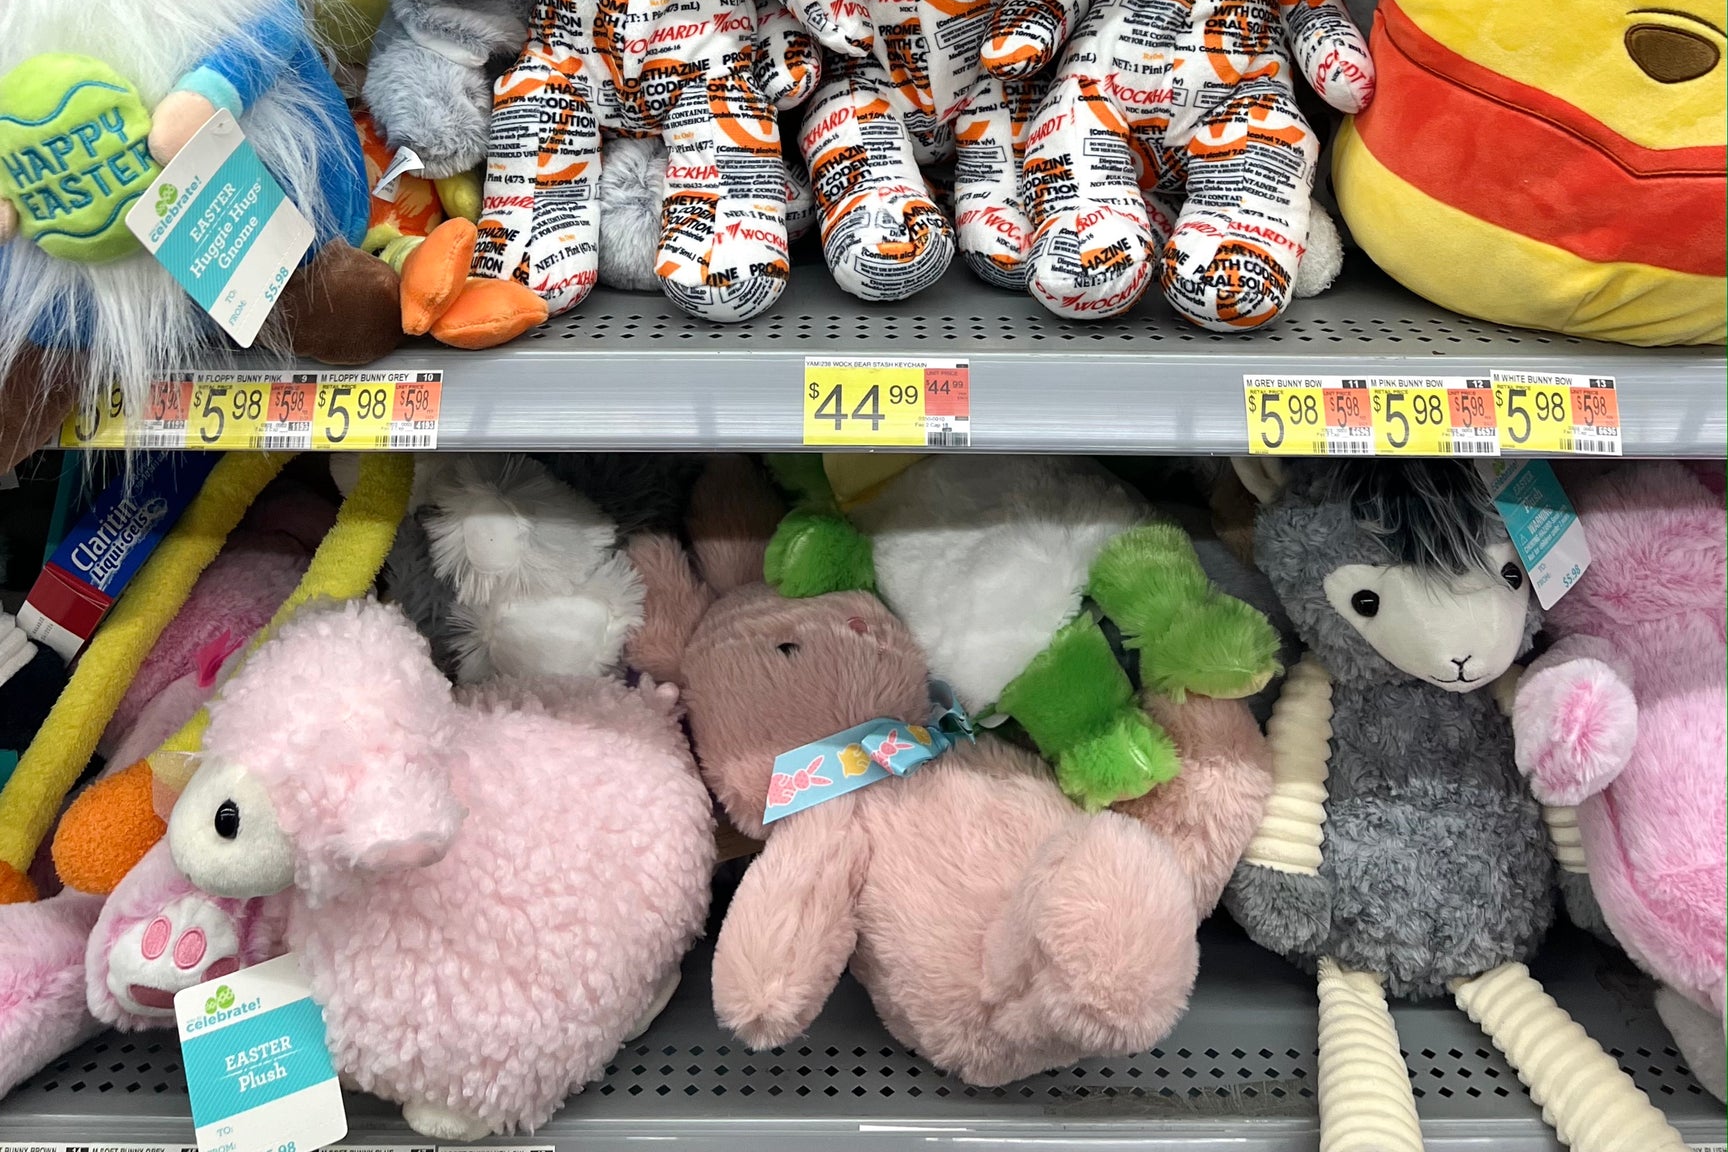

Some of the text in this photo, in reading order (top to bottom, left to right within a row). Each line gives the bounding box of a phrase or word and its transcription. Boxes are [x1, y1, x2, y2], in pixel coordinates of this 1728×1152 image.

[1, 106, 129, 189] HAPPY
[20, 137, 156, 221] EASTER
[150, 175, 203, 244] celebrate!
[189, 182, 236, 243] EASTER
[189, 181, 262, 279] Huggie Hugs
[218, 215, 260, 269] Gnome
[225, 289, 238, 303] TO:
[264, 266, 290, 303] $5.98
[329, 374, 358, 382] FLOPPY
[361, 374, 386, 382] BUNNY
[1379, 379, 1398, 387] PINK
[1399, 379, 1424, 387] BUNNY
[1426, 380, 1443, 388] BOW
[1502, 375, 1526, 383] WHITE
[1528, 376, 1552, 384] BUNNY
[1555, 377, 1573, 385] BOW
[71, 498, 138, 572] Claritin
[1562, 564, 1582, 588] $5.98
[186, 997, 262, 1033] celebrate!
[224, 1035, 293, 1072] EASTER
[238, 1062, 288, 1093] Plush
[216, 1126, 233, 1137] TO:
